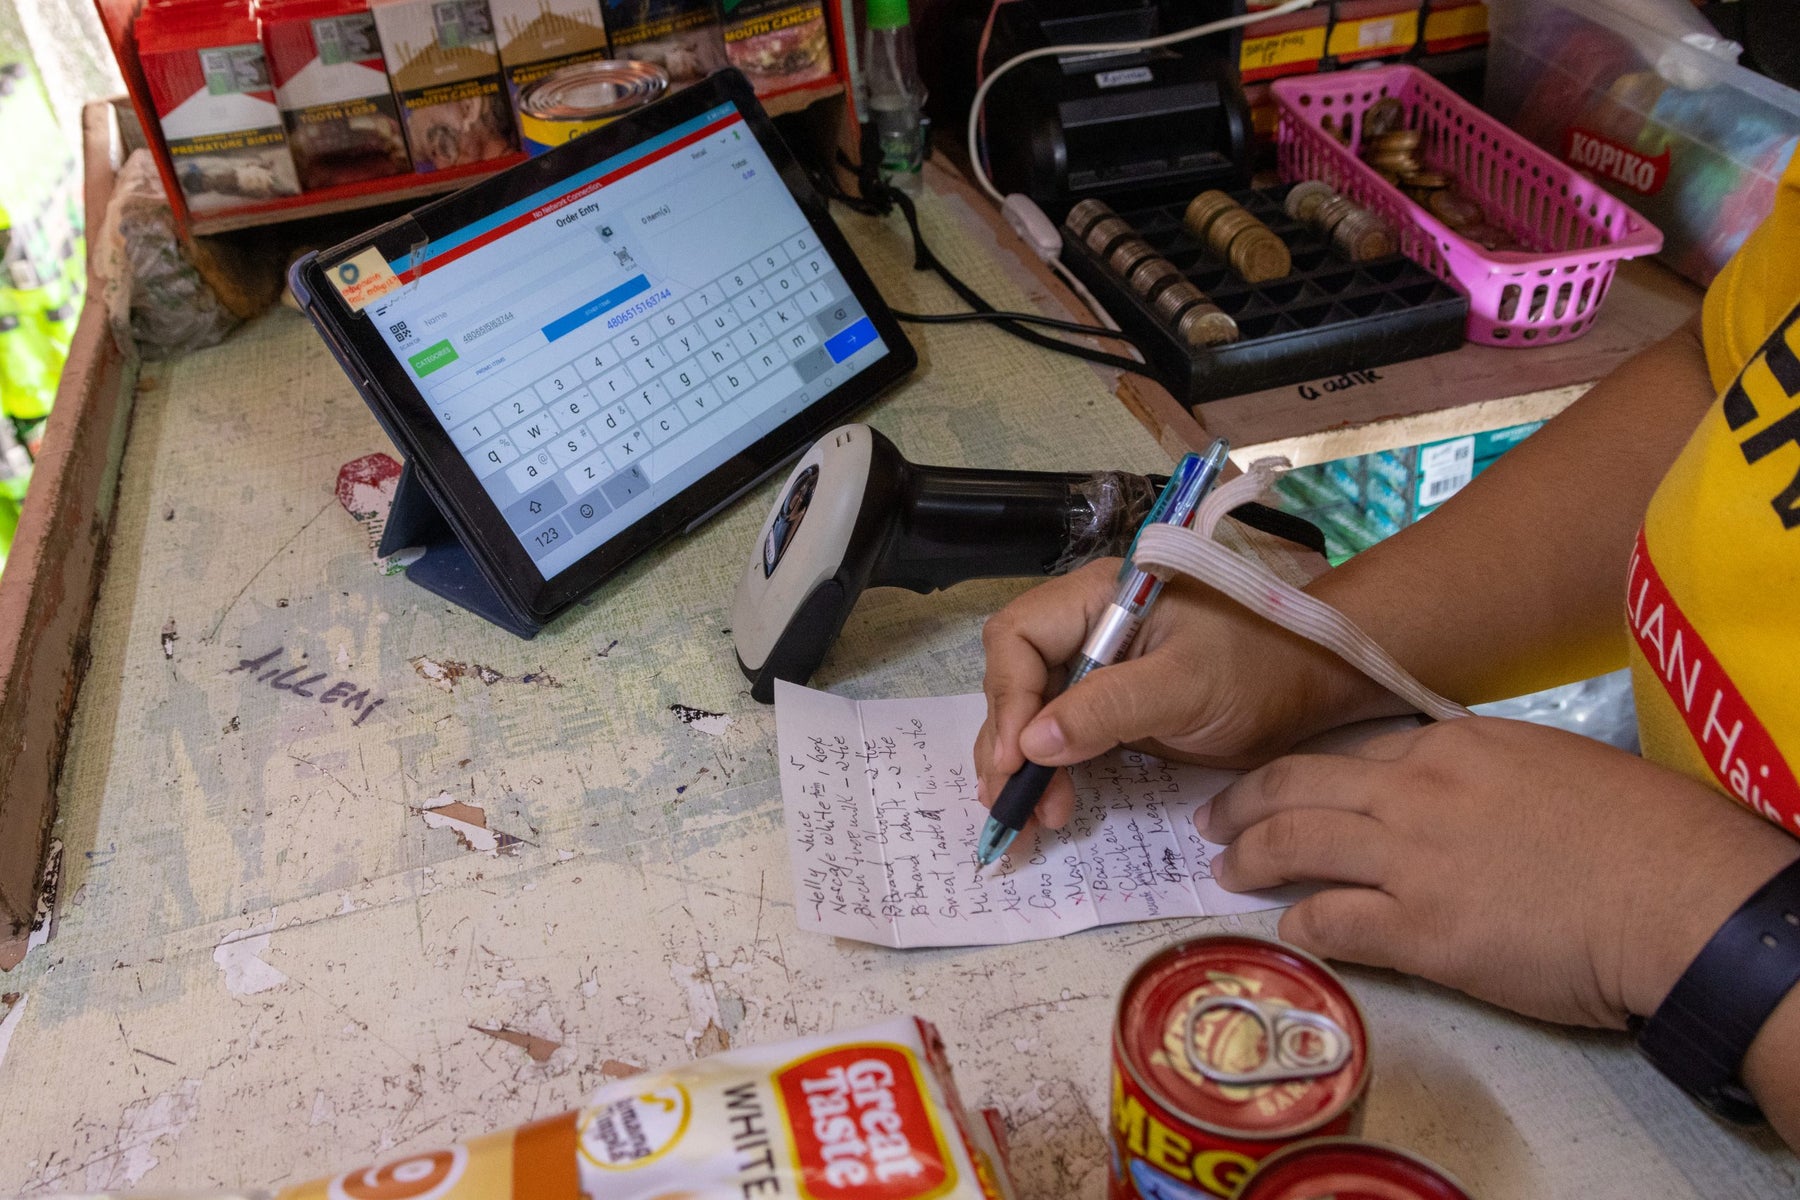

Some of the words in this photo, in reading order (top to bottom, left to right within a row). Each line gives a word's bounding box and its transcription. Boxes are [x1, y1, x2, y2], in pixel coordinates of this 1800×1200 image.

[725, 23, 767, 42] MOUTH
[771, 8, 822, 28] CANCER
[406, 93, 446, 109] MOUTH
[448, 83, 499, 100] CANCER
[171, 138, 243, 155] PREMATURE
[247, 133, 283, 146] BIRTH
[1569, 132, 1656, 192] KOPIKO
[532, 208, 545, 219] No
[543, 197, 568, 216] Network
[555, 212, 580, 228] Order
[578, 202, 600, 221] Entry
[462, 311, 516, 344] 4806515163744
[606, 288, 672, 330] 4806515163744
[415, 346, 452, 370] CATEGORIES
[472, 426, 482, 437] 1
[513, 402, 525, 415] 2
[554, 378, 564, 391] 3
[592, 356, 603, 368] 4
[630, 335, 640, 347] 5
[666, 315, 676, 326] 6
[700, 294, 710, 306] 7
[734, 275, 744, 287] 8
[766, 257, 775, 268] 9
[487, 450, 502, 464] q
[527, 424, 541, 439] w
[569, 403, 580, 414] e
[607, 380, 619, 392] r
[645, 357, 655, 369] t
[680, 336, 691, 352] y
[714, 316, 725, 328] u
[779, 279, 790, 290] o
[810, 260, 820, 274] p
[526, 465, 538, 478] a
[567, 440, 578, 453] s
[606, 413, 617, 429] d
[642, 391, 652, 405] f
[679, 372, 691, 387] g
[711, 350, 724, 363] h
[776, 311, 789, 323] k
[583, 466, 596, 479] z
[622, 442, 634, 455] x
[660, 420, 670, 431] c
[695, 397, 704, 408] v
[726, 375, 739, 388] b
[762, 355, 773, 367] n
[792, 334, 806, 348] m
[535, 527, 560, 548] 123
[930, 871, 959, 919] Great
[723, 1081, 780, 1200] WHITE
[801, 1067, 868, 1189] Taste
[847, 1058, 924, 1182] Great
[1113, 1094, 1260, 1199] MEG
